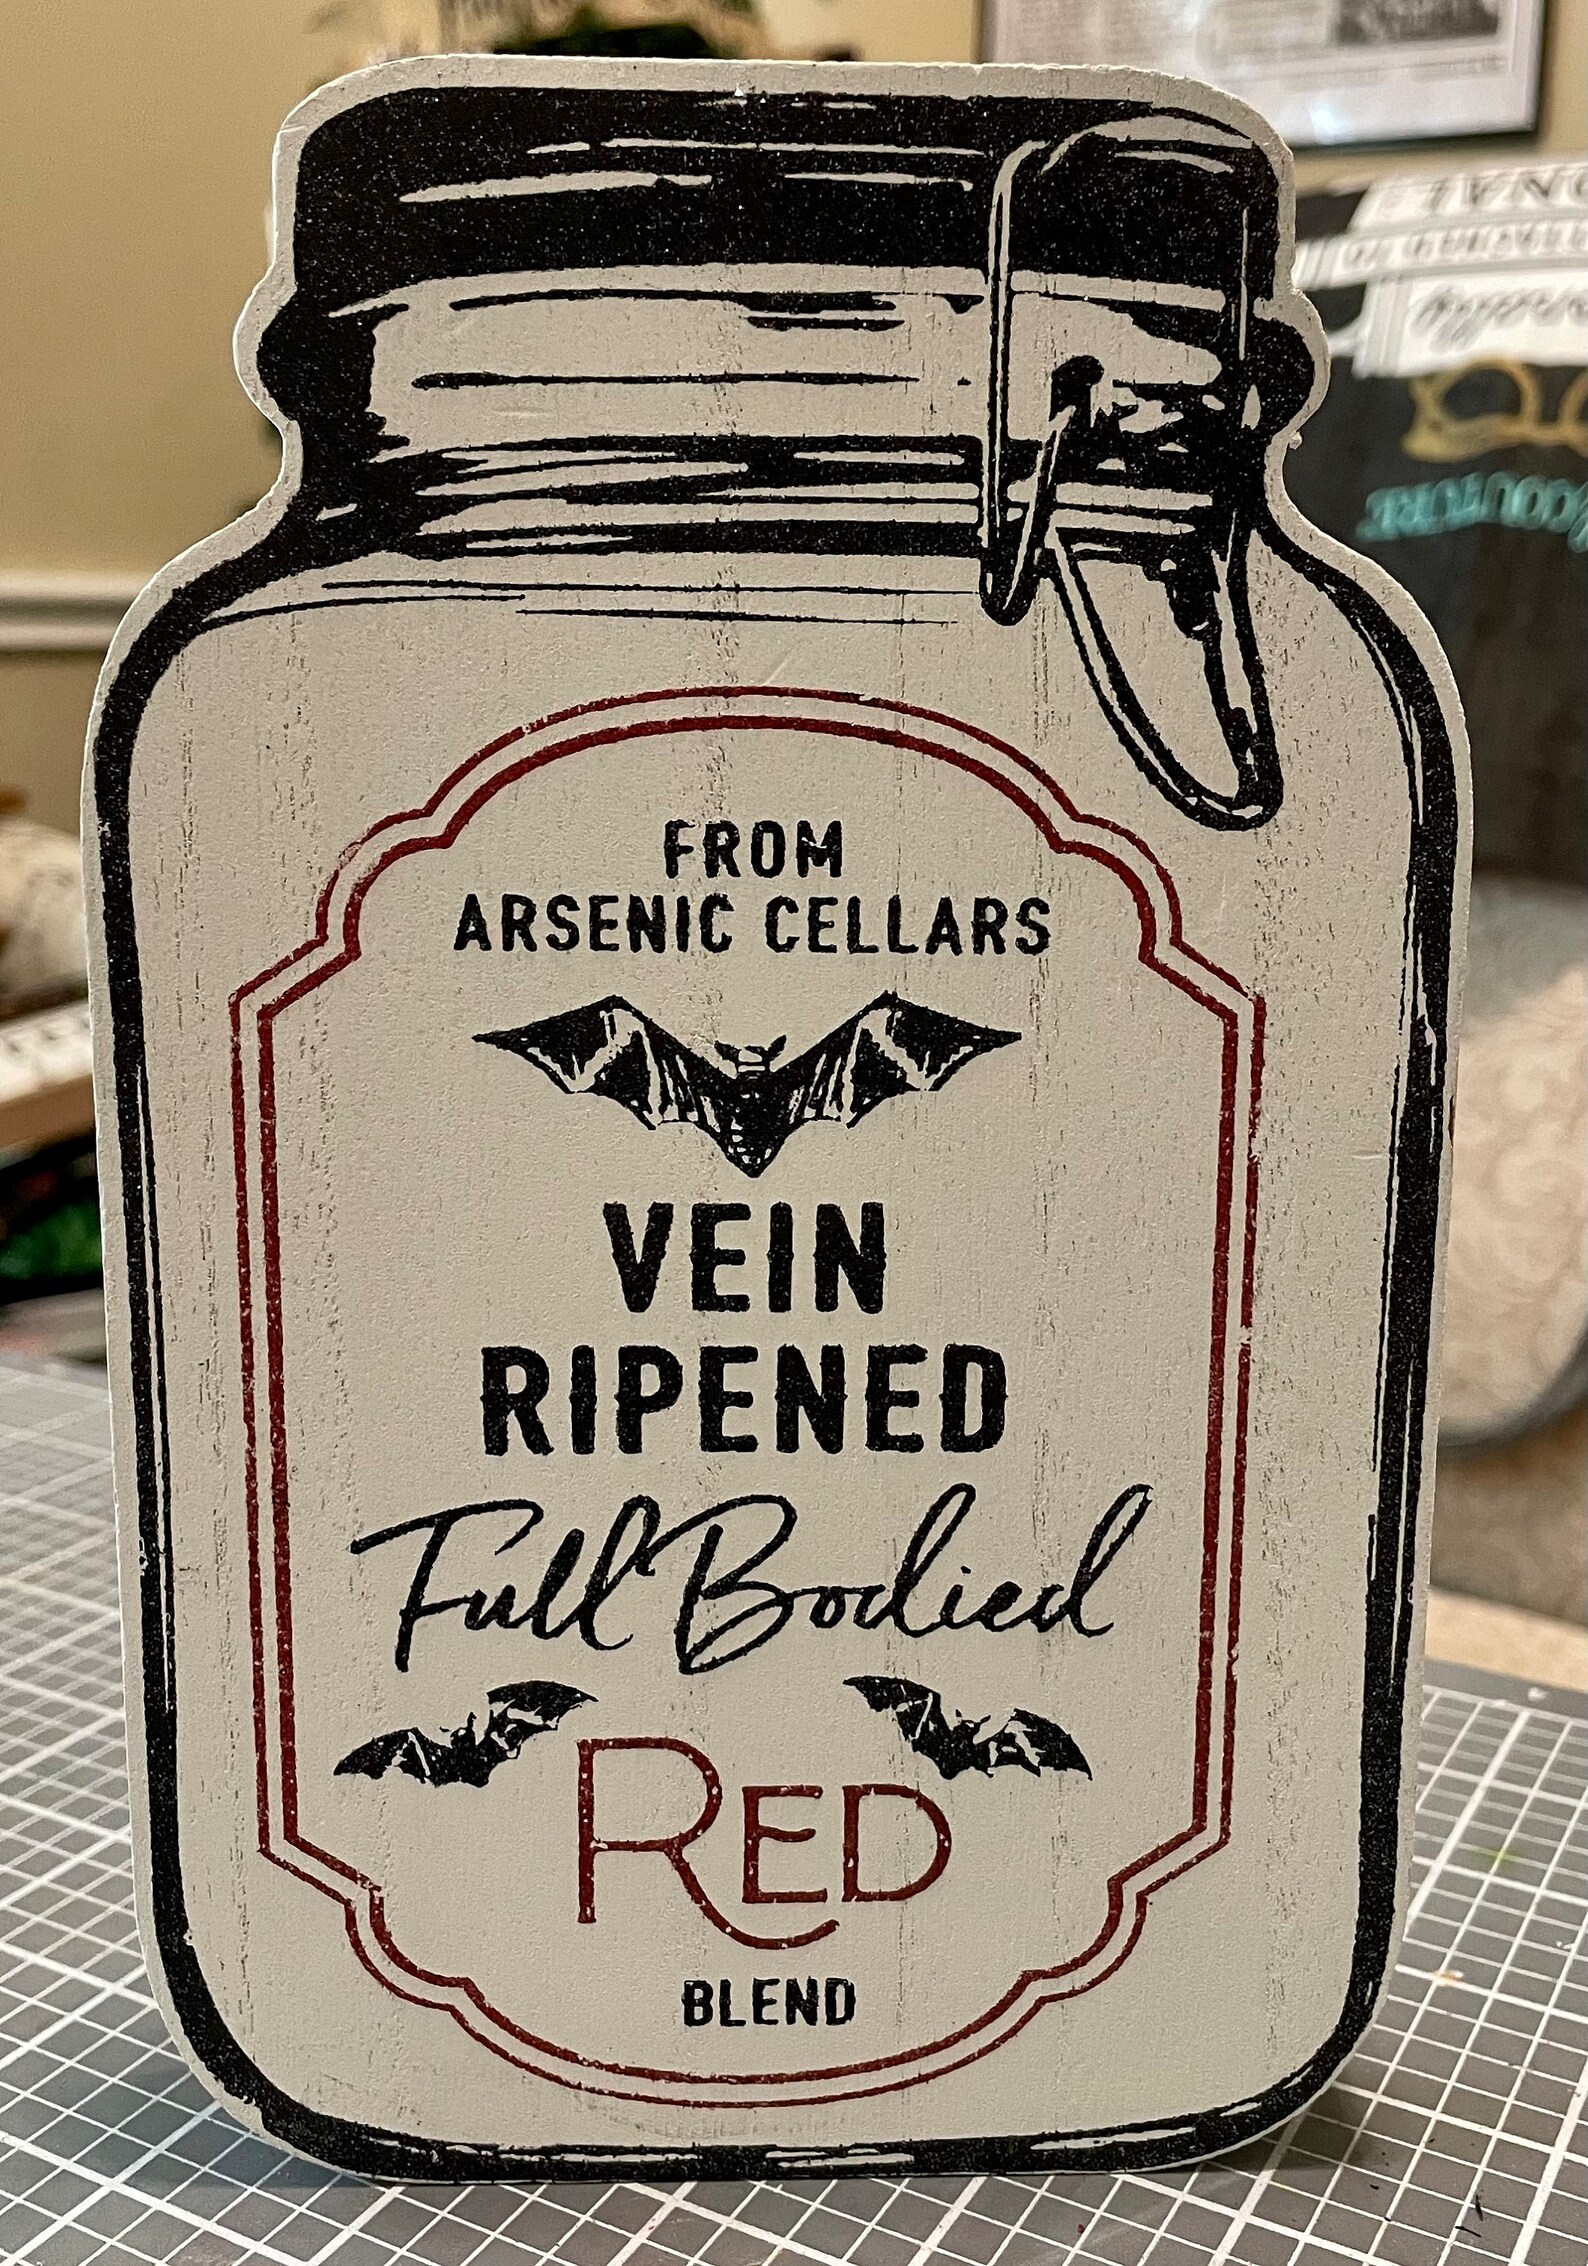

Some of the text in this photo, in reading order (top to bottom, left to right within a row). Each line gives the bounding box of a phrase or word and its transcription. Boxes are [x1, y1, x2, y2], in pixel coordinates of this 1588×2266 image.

[664, 819, 842, 879] FROM
[454, 893, 1051, 956] ARSENIC CELLARS
[603, 1202, 887, 1314] VEIN
[480, 1343, 1008, 1456] RIPENED
[350, 1483, 1153, 1675] Full Bodied
[577, 1736, 952, 1950] RED
[681, 1976, 856, 2027] BLEND
